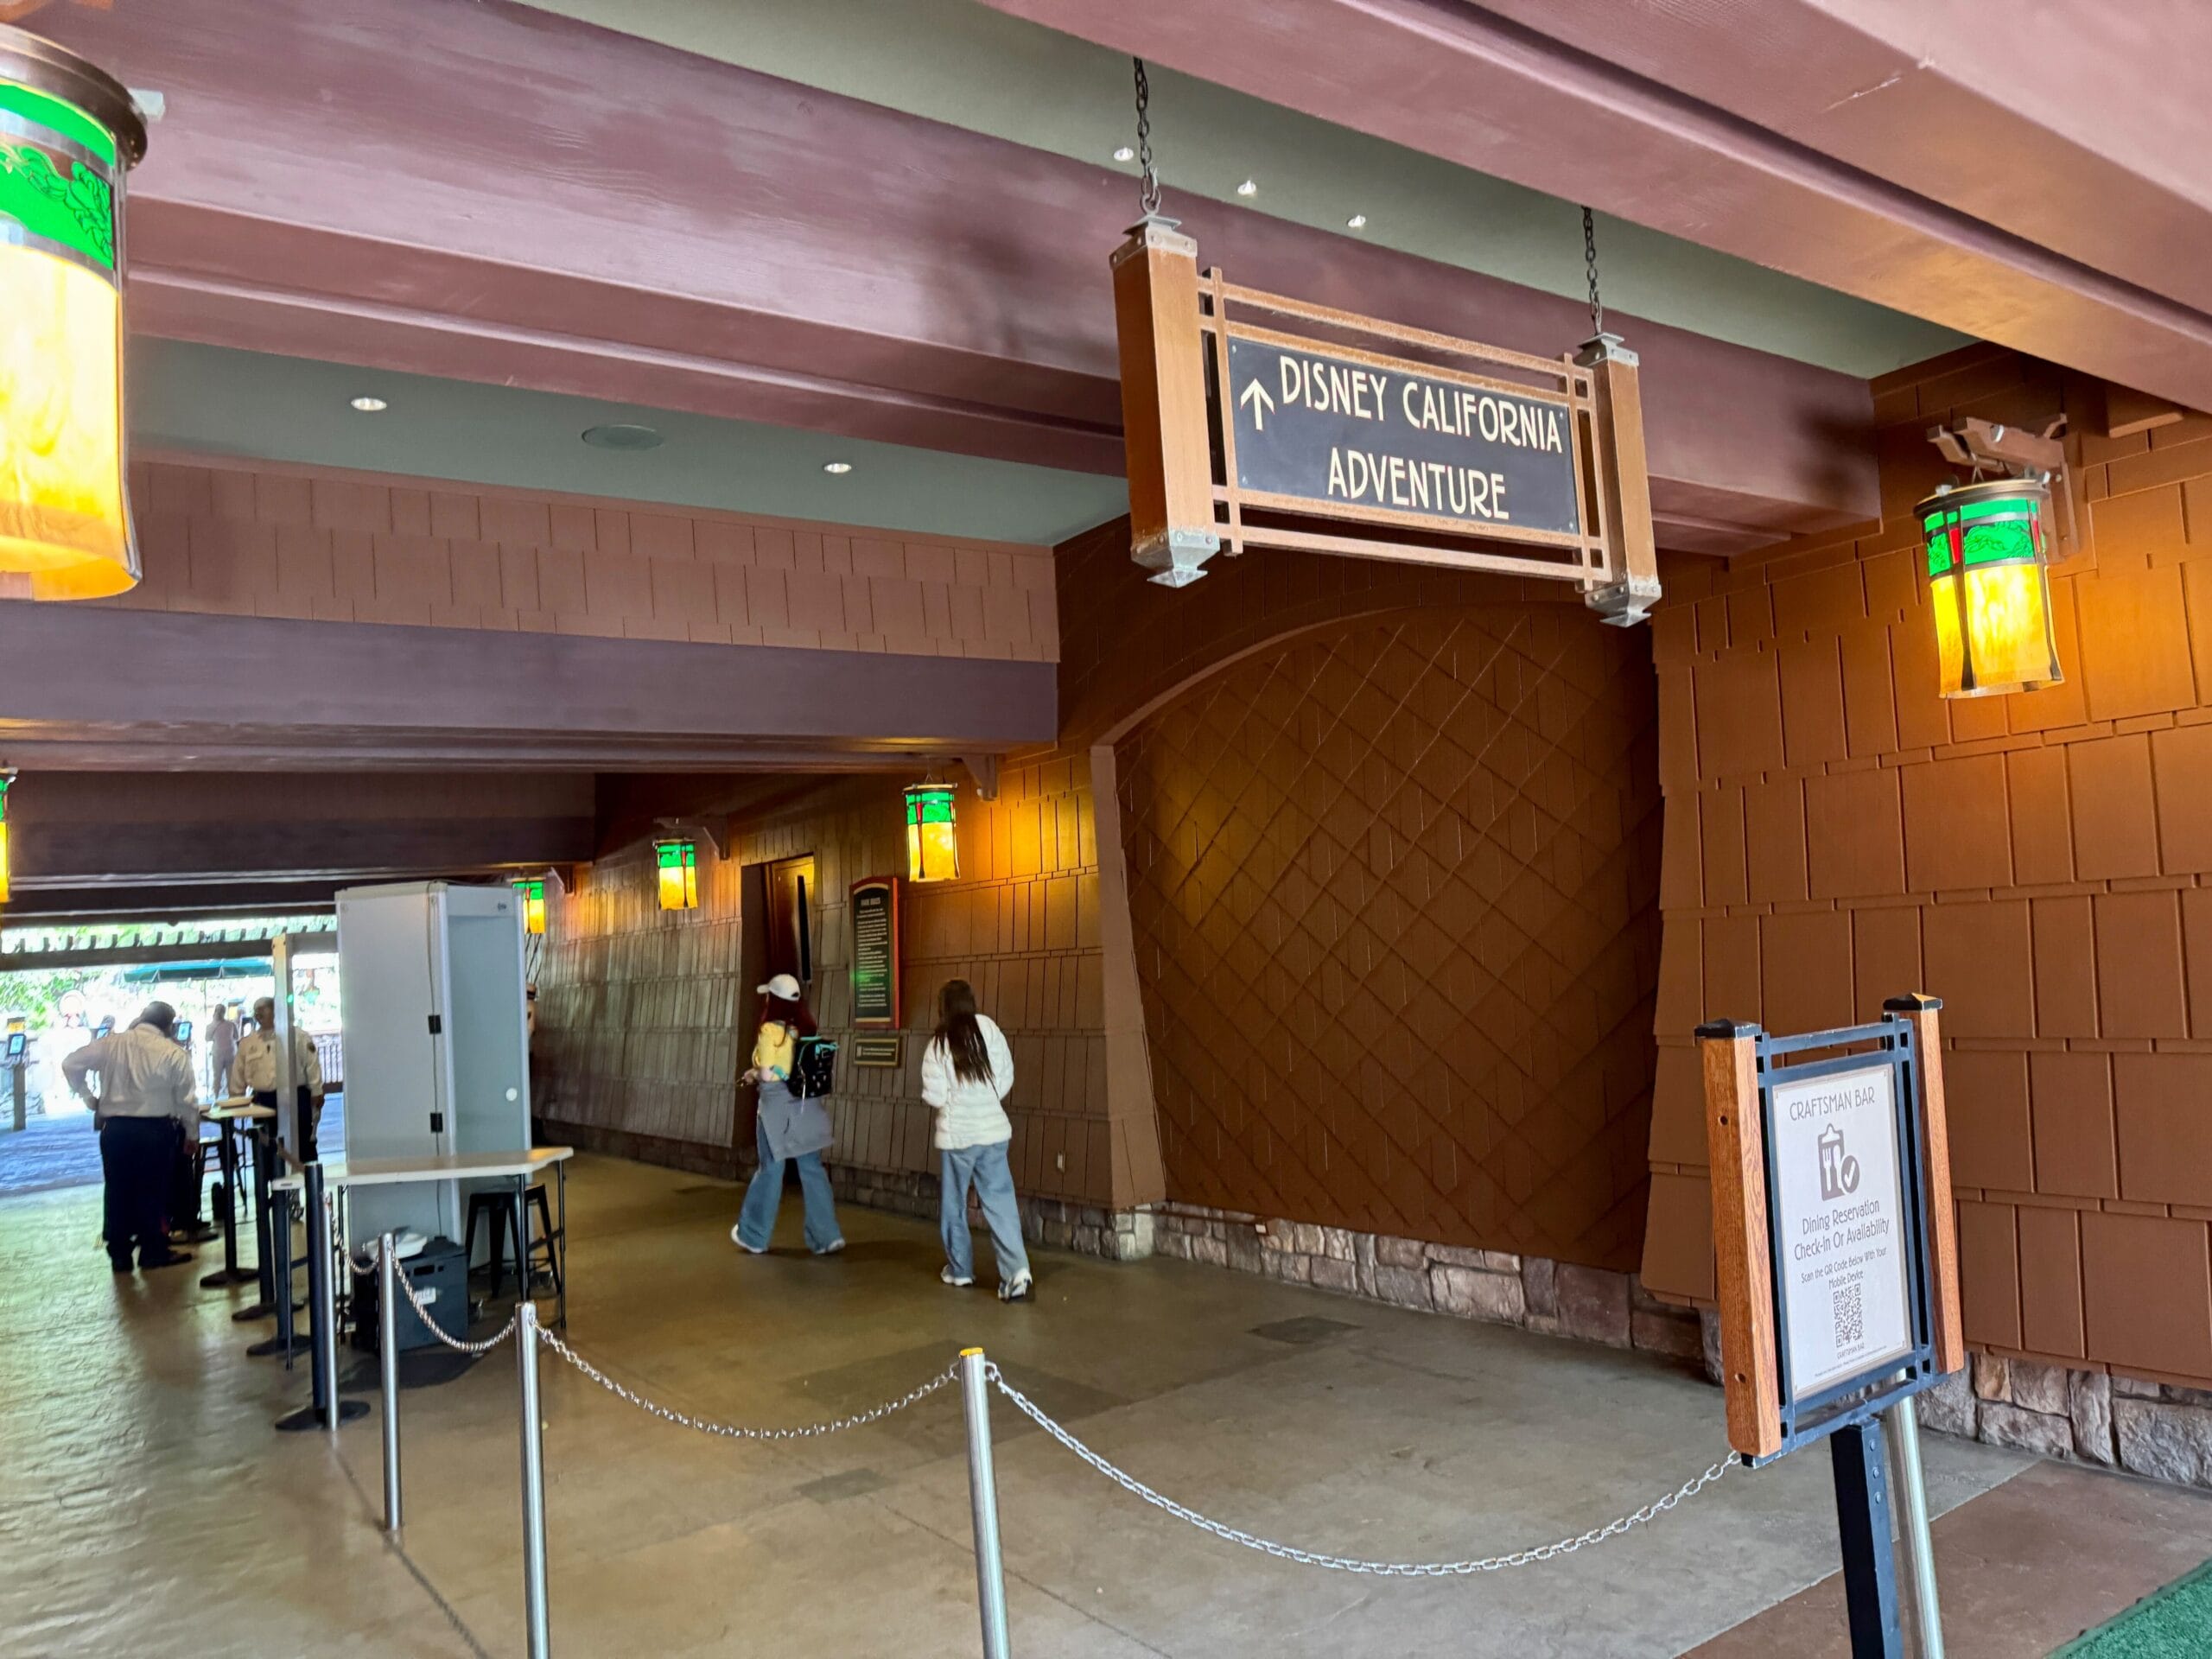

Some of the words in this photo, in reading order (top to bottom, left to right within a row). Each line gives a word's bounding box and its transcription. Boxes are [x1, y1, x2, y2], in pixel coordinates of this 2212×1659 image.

[1280, 355, 1387, 422] DISNEY
[1402, 381, 1563, 453] CALIFORNIA
[1328, 447, 1510, 518] ADVENTURE
[1789, 1090, 1853, 1121] CRAFTSMAN
[1854, 1086, 1875, 1108] BAR
[1802, 1215, 1830, 1235] Dining
[1832, 1199, 1880, 1227] Reservation
[1833, 1231, 1844, 1249] Or
[1847, 1218, 1889, 1244] Availability
[1801, 1272, 1814, 1283] Scan
[1824, 1262, 1834, 1275] QR
[1834, 1261, 1847, 1272] Code
[1848, 1255, 1863, 1267] Below
[1876, 1247, 1887, 1258] Your
[1828, 1278, 1847, 1290] Mobile
[1847, 1269, 1864, 1283] Device
